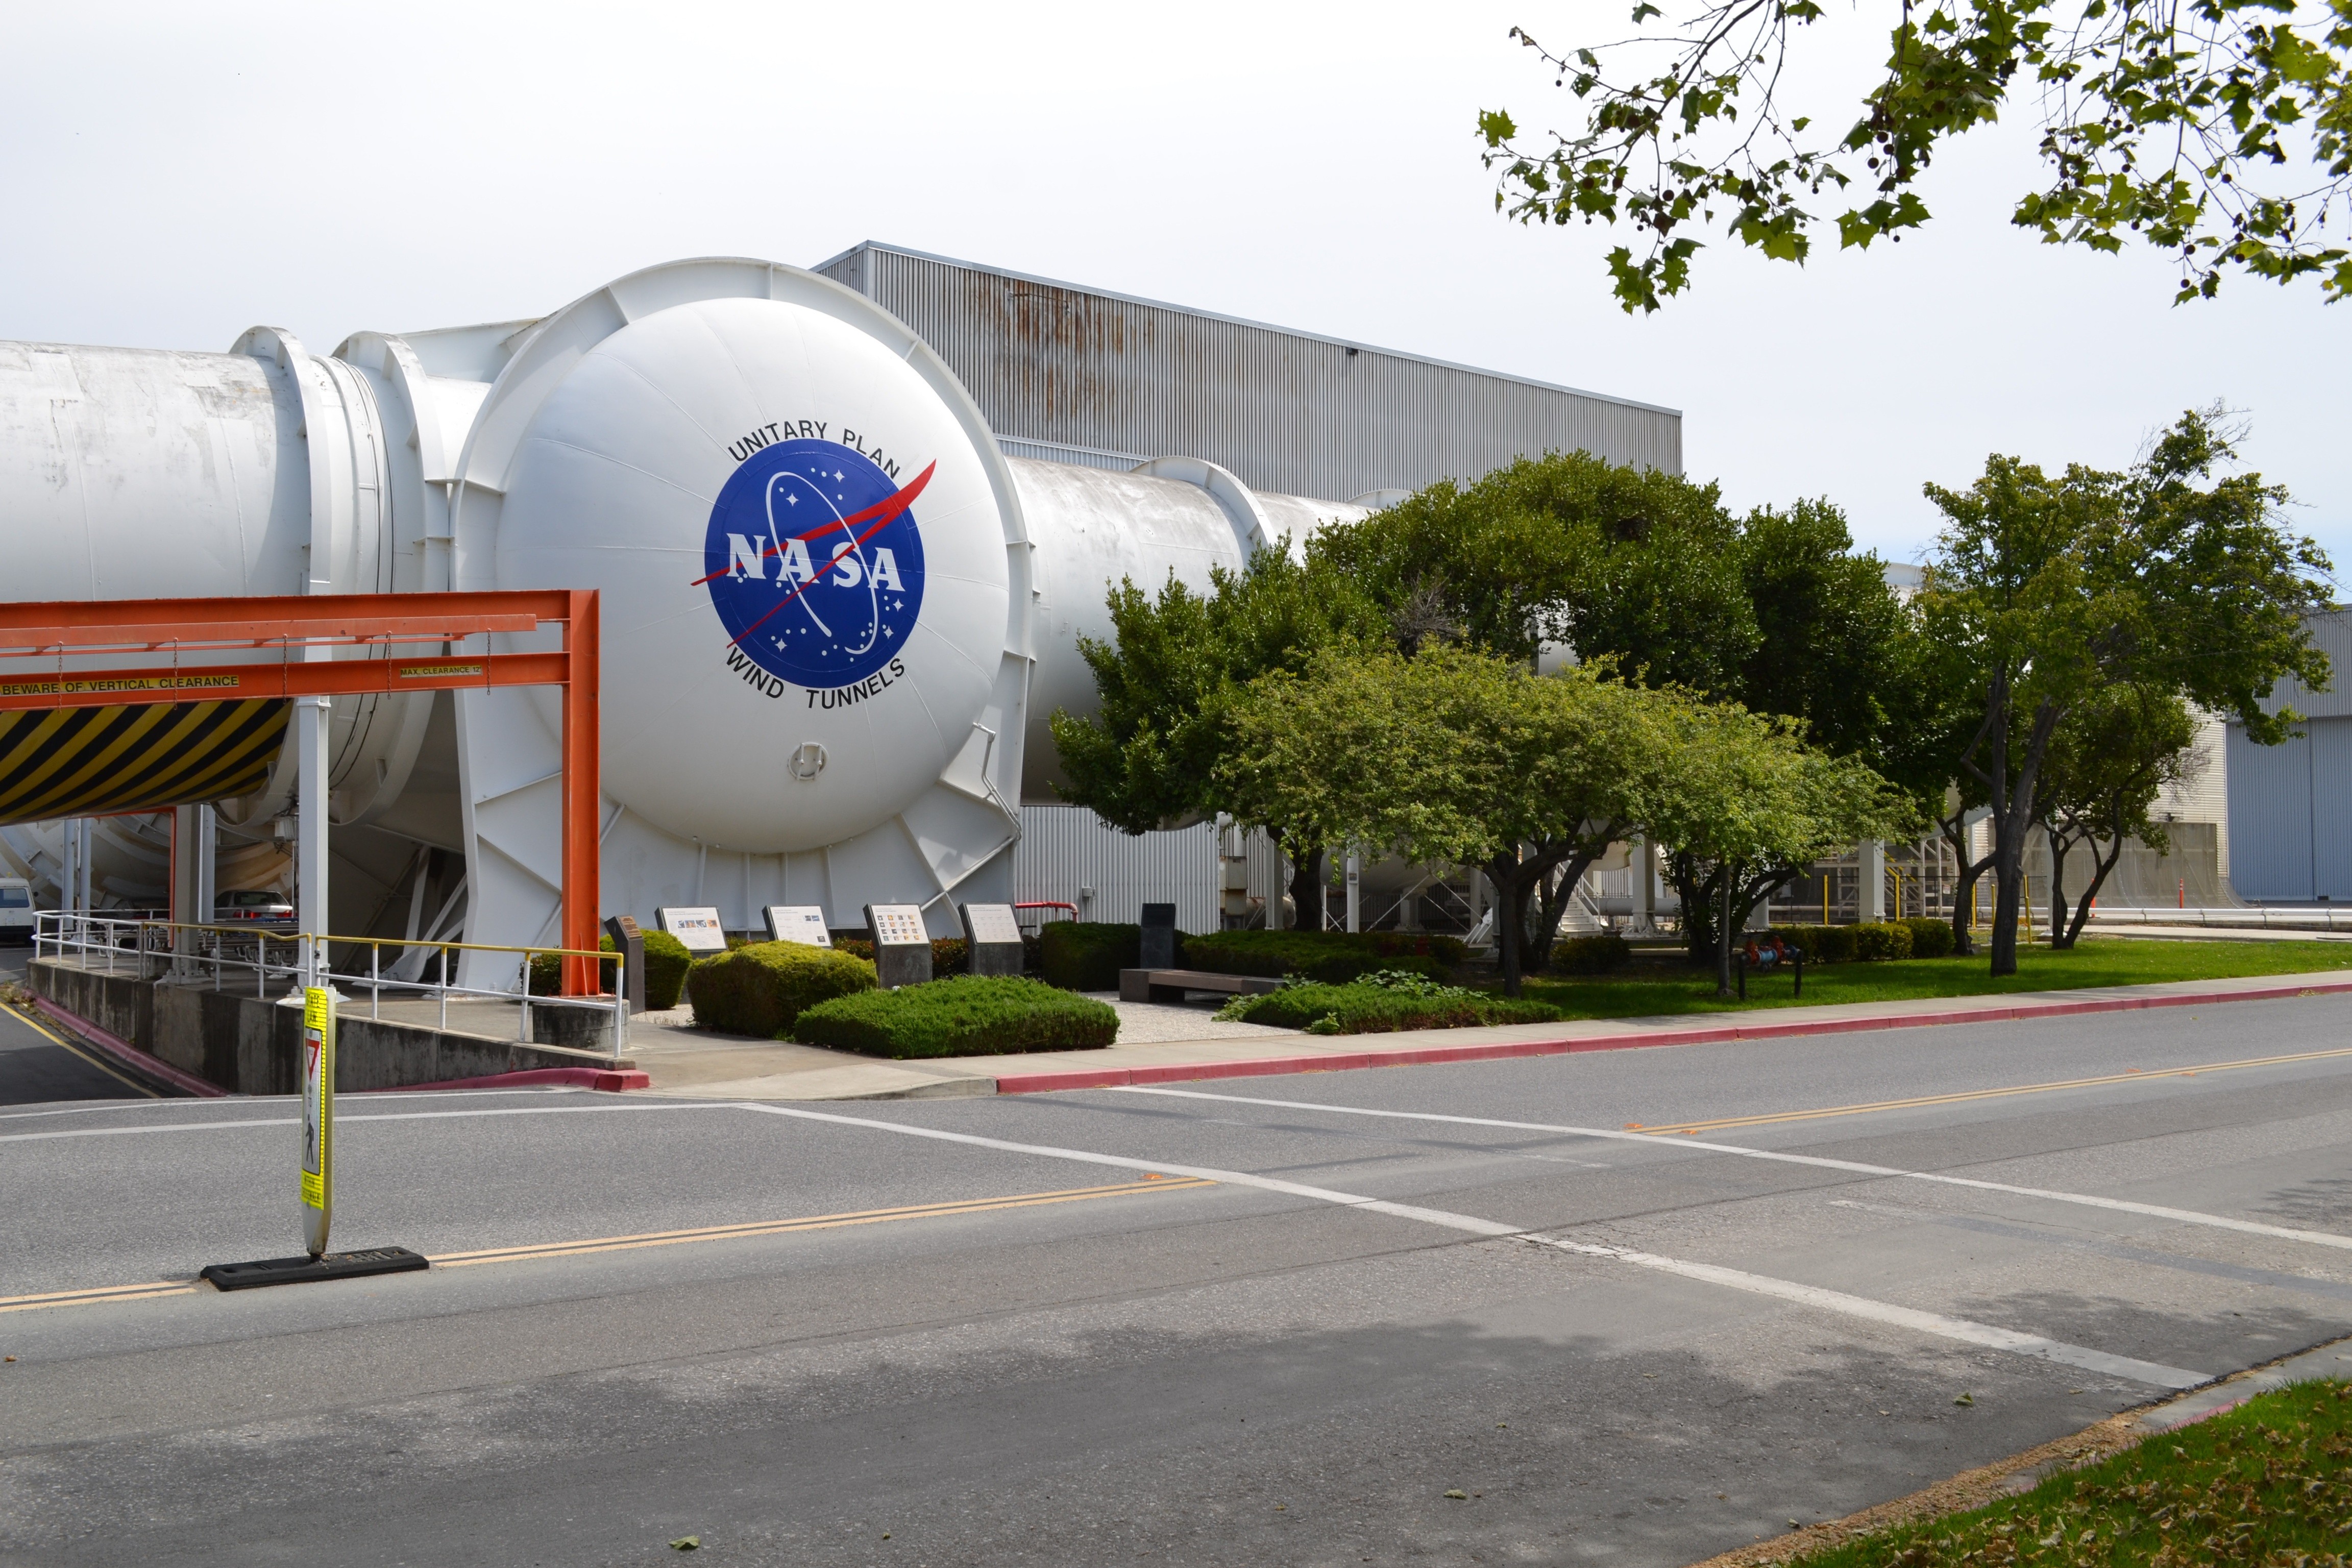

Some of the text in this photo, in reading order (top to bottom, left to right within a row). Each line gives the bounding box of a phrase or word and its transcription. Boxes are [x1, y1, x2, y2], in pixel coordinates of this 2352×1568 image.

[728, 420, 900, 479] UNITARY PLAN
[726, 533, 905, 592] NASA
[3, 676, 238, 695] BEWARE OF VERTICAL CLEARANCE
[423, 666, 470, 674] CLEARANCE
[726, 647, 904, 709] WIND TUNNELS
